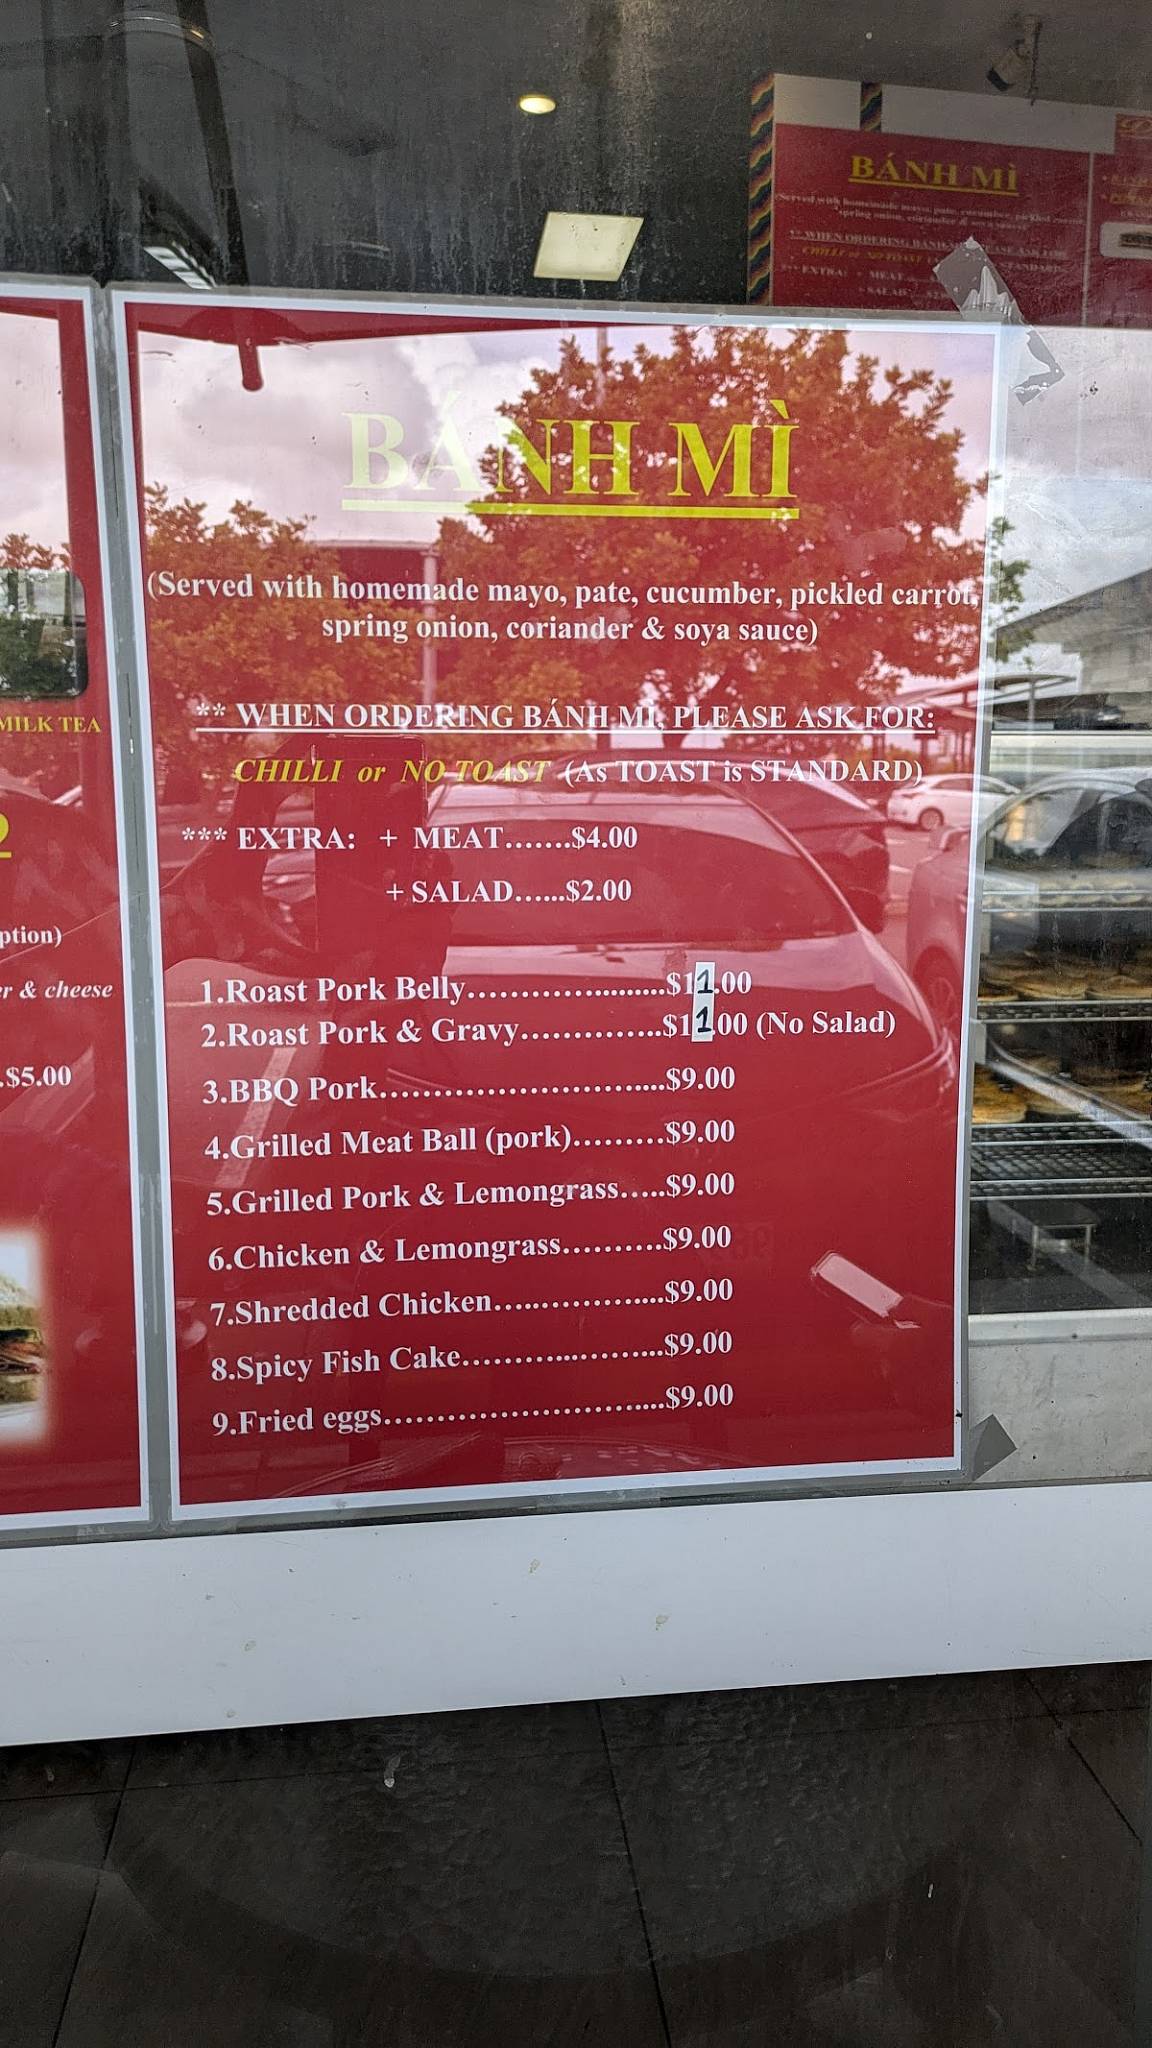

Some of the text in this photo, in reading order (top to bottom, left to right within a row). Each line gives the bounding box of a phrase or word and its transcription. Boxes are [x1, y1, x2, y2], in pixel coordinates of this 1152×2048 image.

[851, 153, 1019, 192] BÁNH MÌ
[341, 389, 800, 498] BÁNH MÌ
[147, 571, 979, 610] (Served with homemade mayo, pate, cucumber, pickled carrot,
[322, 613, 818, 646] spring onion, coriander & soya sauce)
[0, 716, 101, 732] MILK TEA
[236, 703, 334, 727] WHEN
[344, 703, 513, 728] ORDERING
[523, 698, 609, 728] BÁNH
[673, 705, 786, 729] PLEASE
[796, 705, 855, 729] ASK
[864, 706, 935, 729] FOR:
[235, 759, 923, 788] CHILLI or NO TOAST (As TOAST is STANDARD)
[238, 827, 355, 850] EXTRA:
[379, 829, 398, 848] +
[386, 884, 404, 901] +
[19, 980, 37, 999] &
[45, 980, 113, 998] cheese
[201, 978, 308, 1005] 1.Roast
[318, 977, 387, 1002] Pork
[201, 1021, 309, 1048] 2.Roast
[319, 1019, 388, 1045] Pork
[395, 1019, 422, 1044] &
[756, 1011, 804, 1040] (No
[812, 1009, 896, 1039] Salad)
[202, 1078, 299, 1106] 3.BBQ
[204, 1132, 331, 1160] 4.Grilled
[341, 1129, 413, 1155] Meat
[422, 1126, 476, 1151] Ball
[206, 1187, 332, 1216] 5.Grilled
[342, 1184, 411, 1210] Pork
[419, 1182, 444, 1206] &
[208, 1243, 350, 1271] 6.Chicken
[359, 1239, 385, 1264] &
[210, 1294, 370, 1326] 7.Shredded
[211, 1355, 313, 1384] 8.Spicy
[322, 1348, 380, 1375] Fish
[212, 1407, 313, 1436] 9.Fried
